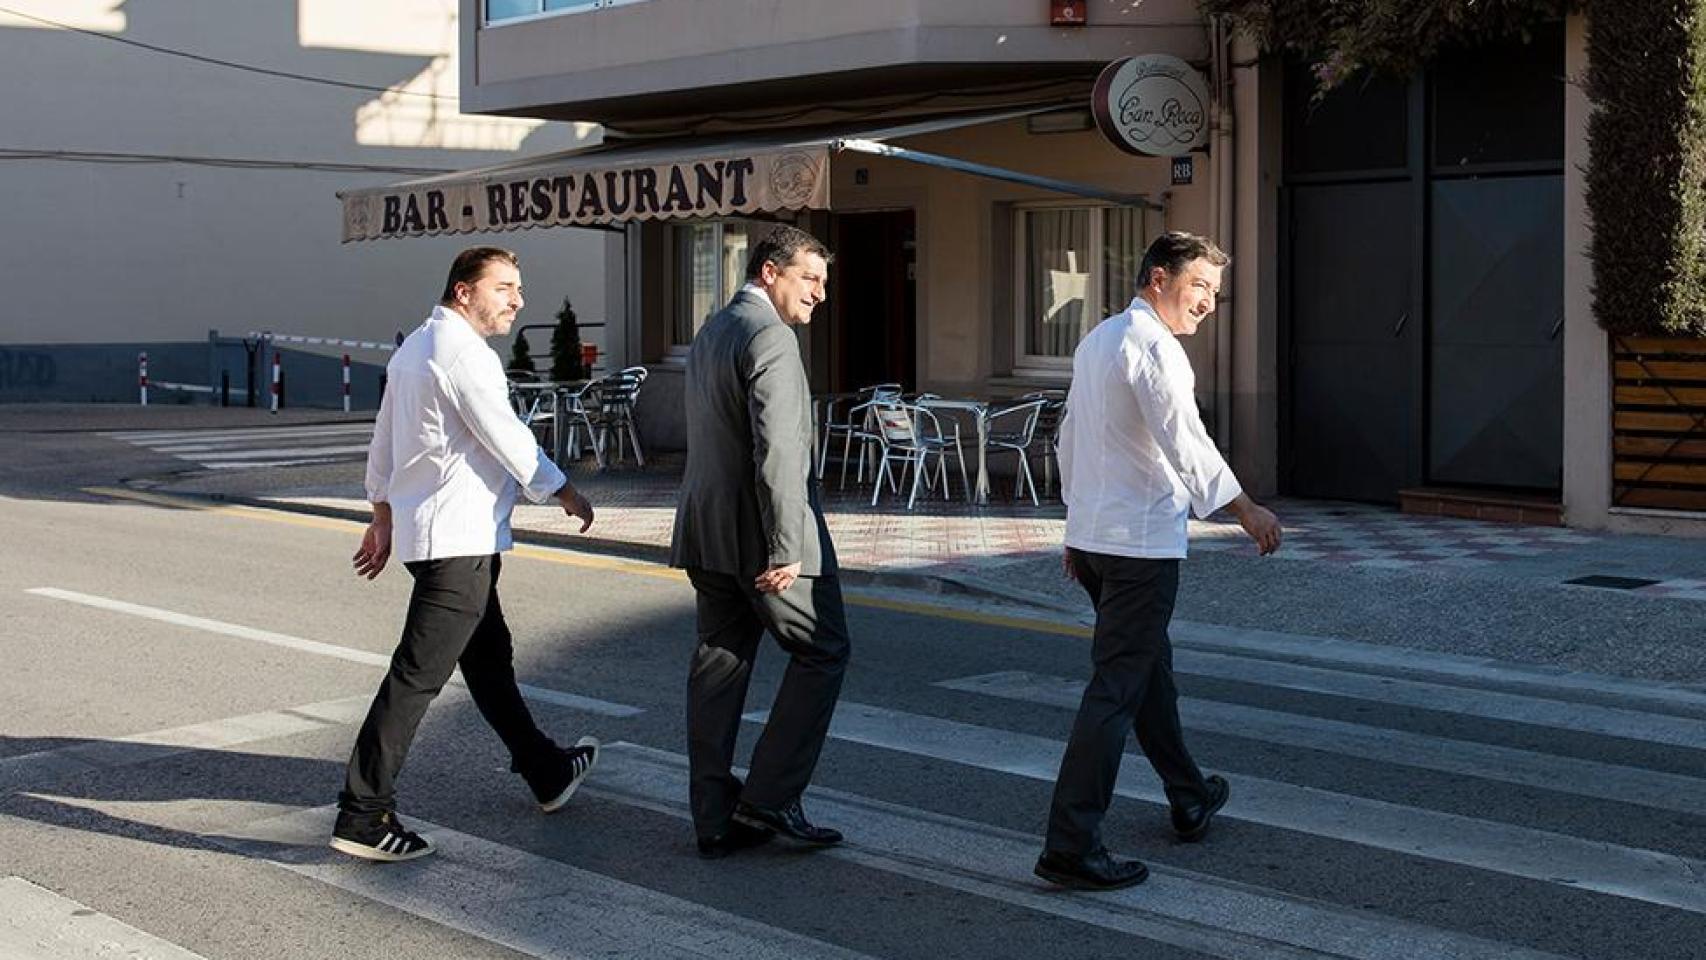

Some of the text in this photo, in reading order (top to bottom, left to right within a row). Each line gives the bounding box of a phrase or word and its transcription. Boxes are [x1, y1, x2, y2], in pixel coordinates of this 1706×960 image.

[1119, 96, 1200, 128] Can Roca
[382, 190, 449, 233] BAR
[487, 157, 754, 226] RESTAURANT
